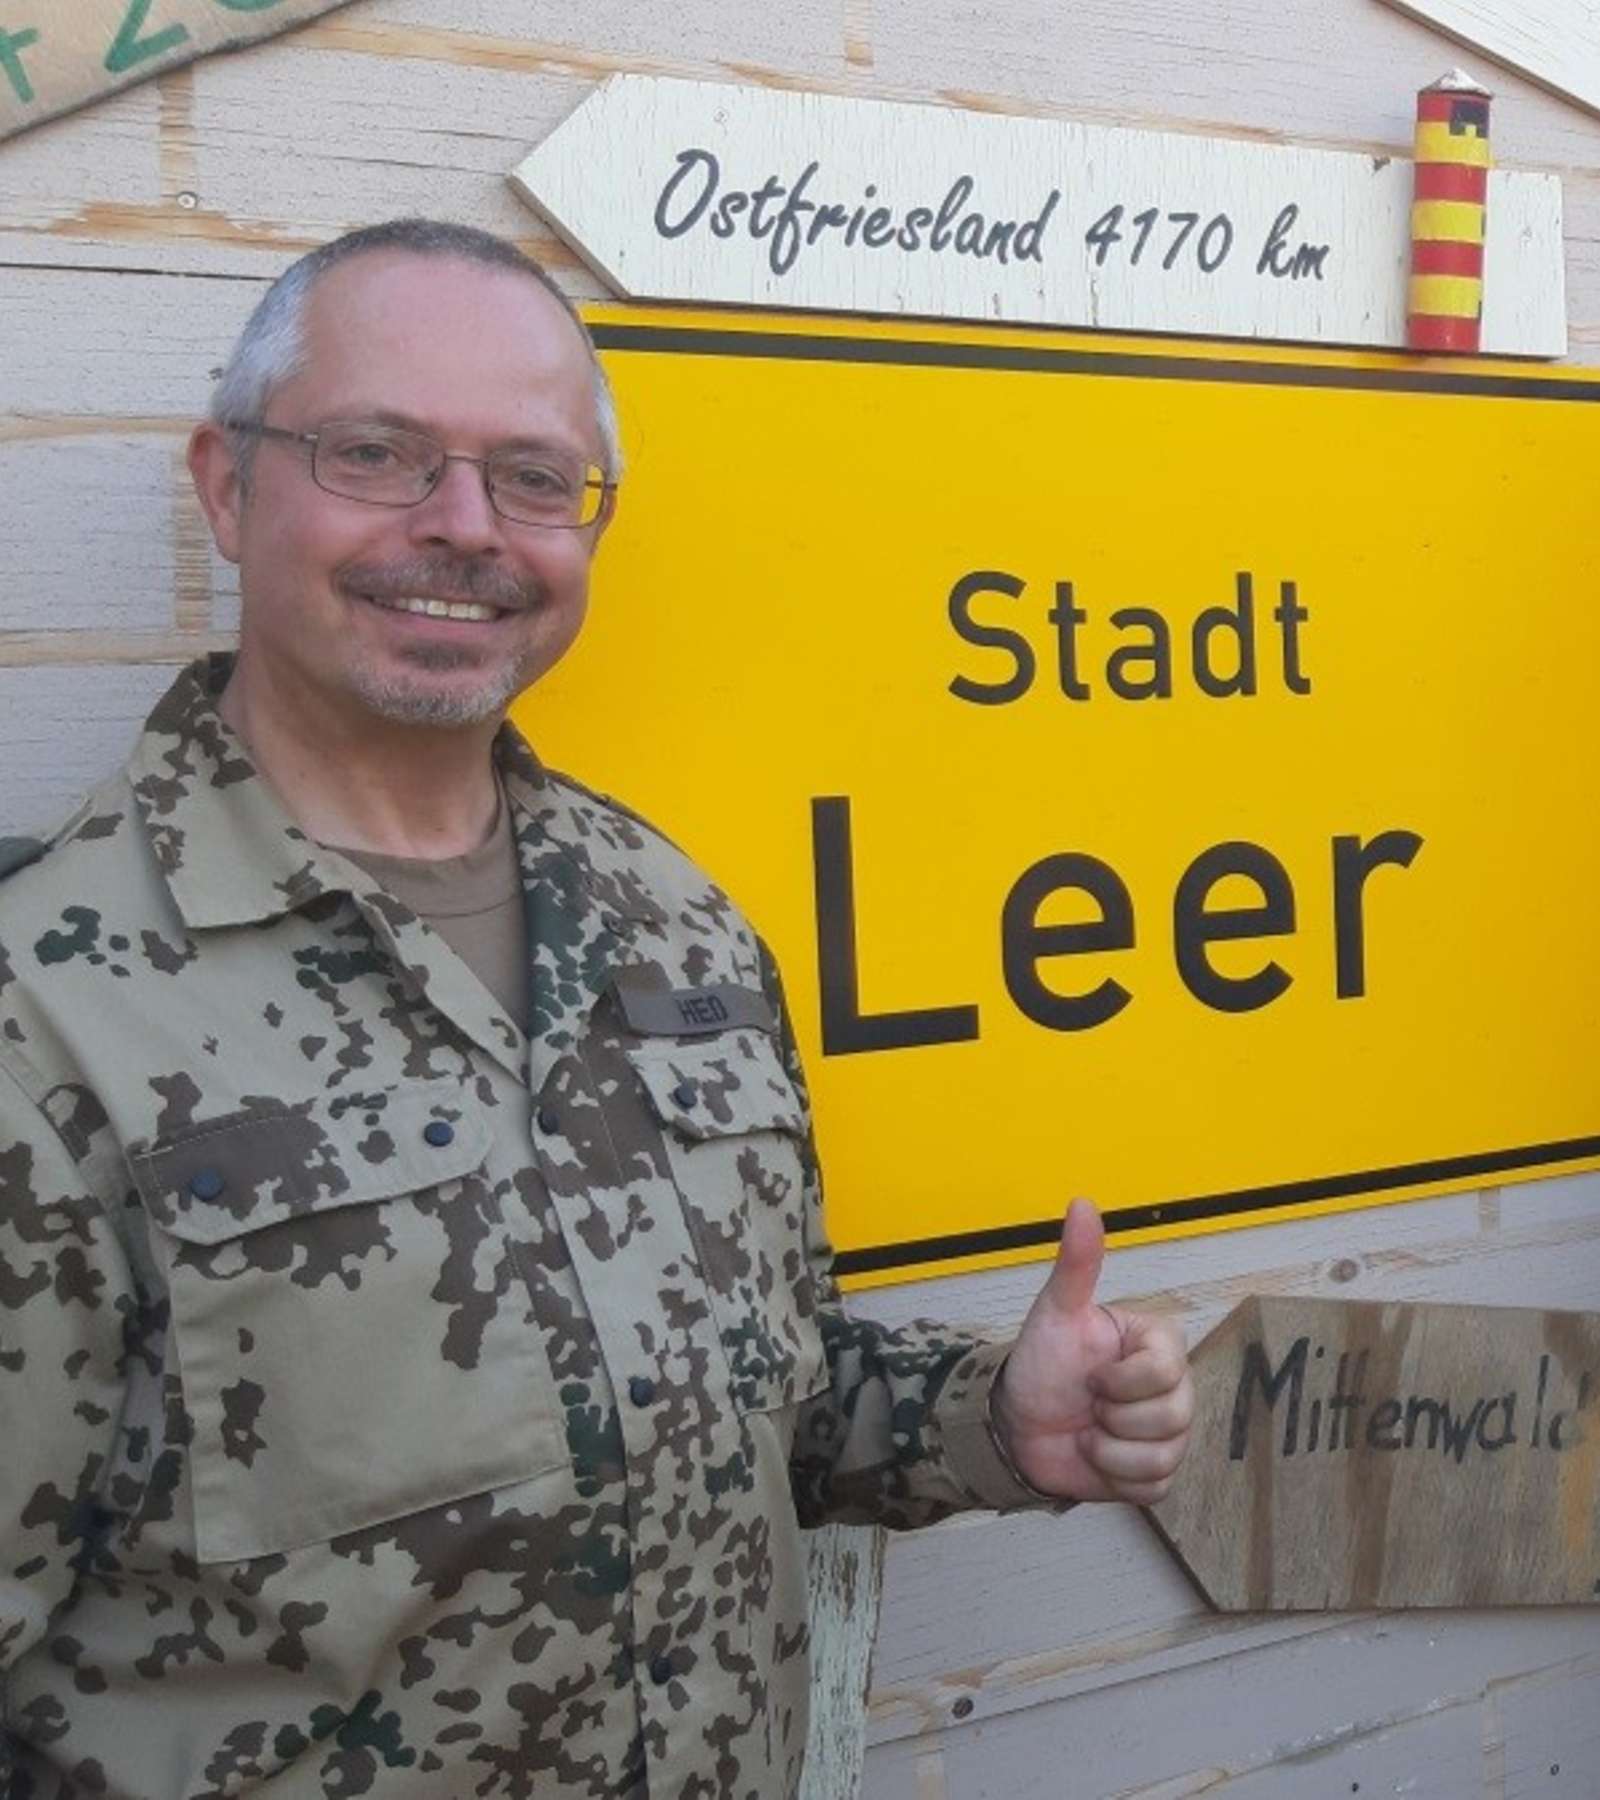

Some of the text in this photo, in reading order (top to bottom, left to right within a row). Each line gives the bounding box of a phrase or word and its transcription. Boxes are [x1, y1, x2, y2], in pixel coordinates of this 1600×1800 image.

[654, 148, 1330, 281] Ostfriesland 4170 km
[948, 570, 1312, 706] Stadt
[811, 795, 1425, 1058] Leer
[1229, 1335, 1591, 1464] Mittenwald
